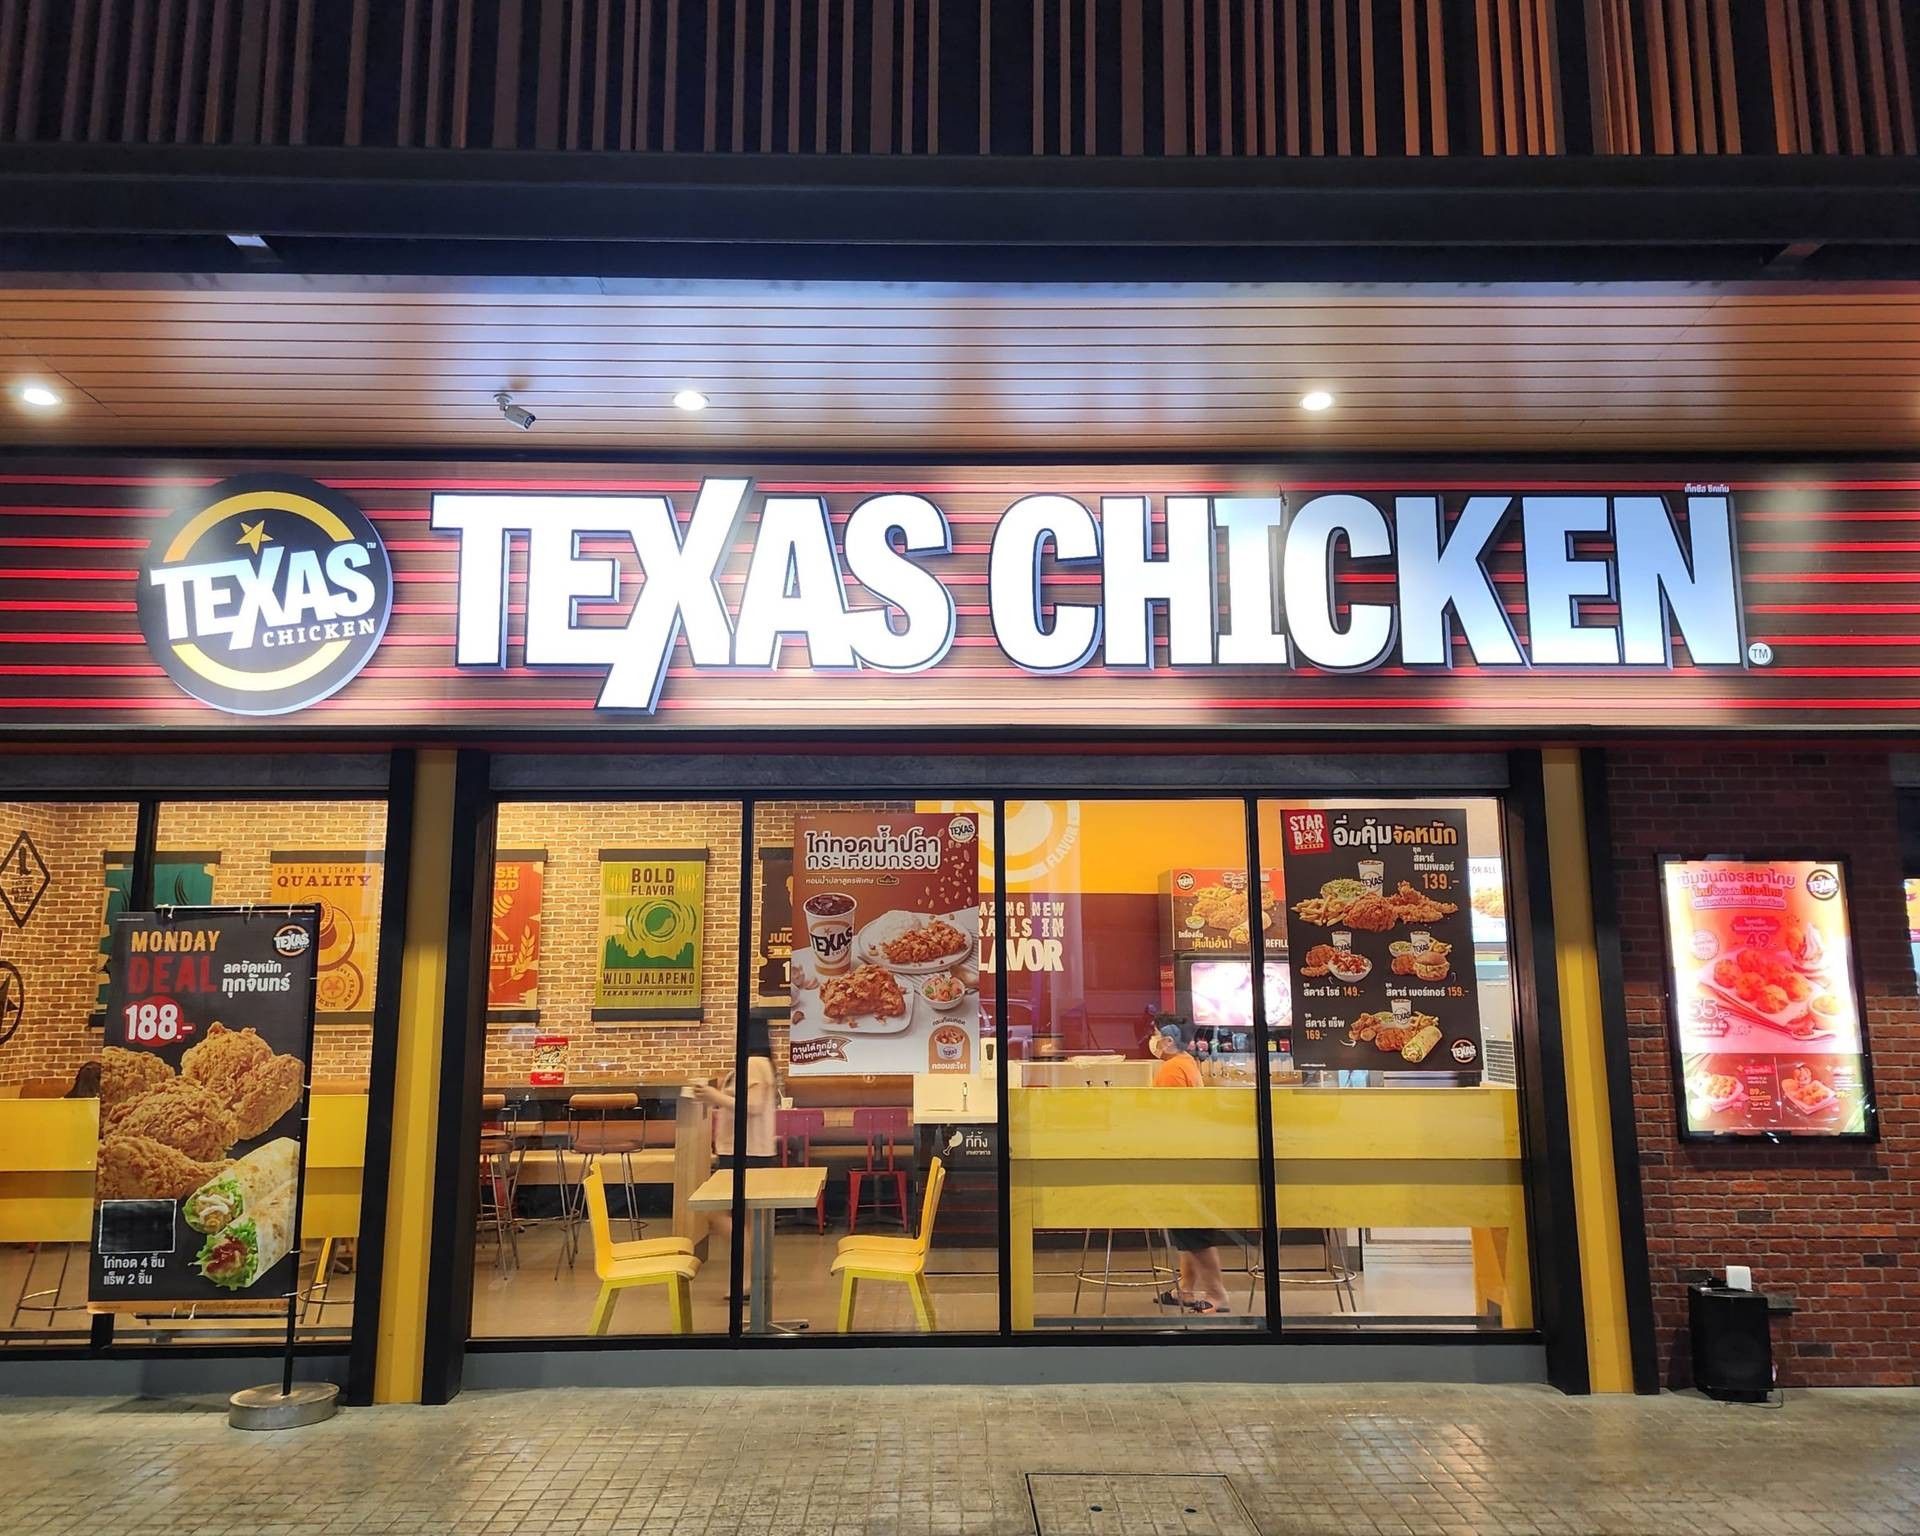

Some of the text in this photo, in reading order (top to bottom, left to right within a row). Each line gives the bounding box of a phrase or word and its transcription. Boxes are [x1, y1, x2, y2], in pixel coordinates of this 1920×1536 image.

[150, 543, 376, 650] TEXAS
[431, 476, 1742, 714] TEXAS CHICKEN
[262, 618, 376, 648] CHICKEN
[1290, 814, 1324, 830] STAR
[949, 825, 974, 836] TEXAS
[806, 826, 939, 853] ไก่ทอดน้ำปลา
[807, 853, 939, 868] กระเทียมกรอบ
[277, 876, 372, 888] QUALITY
[631, 868, 675, 883] BOLD
[1422, 873, 1460, 891] 139.-
[631, 885, 675, 896] FLAVOR
[1032, 902, 1064, 916] NEW
[1041, 918, 1065, 937] IN
[131, 930, 220, 953] MONDAY
[274, 932, 310, 950] TEXAS
[128, 956, 217, 993] DEAL
[223, 960, 282, 974] ลดจัดหนัก
[222, 972, 291, 998] ทุกจันทร์
[603, 972, 695, 985] WILD JALAPENO
[603, 989, 694, 997] TEXAS WITH A TWIST
[125, 1004, 193, 1040] 188.-
[965, 1131, 988, 1147] ที่ทิ้ง
[103, 1252, 165, 1269] ไก่ทอด 4 ชิ้น
[127, 1274, 135, 1284] 2
[138, 1269, 152, 1284] ชิ้น
